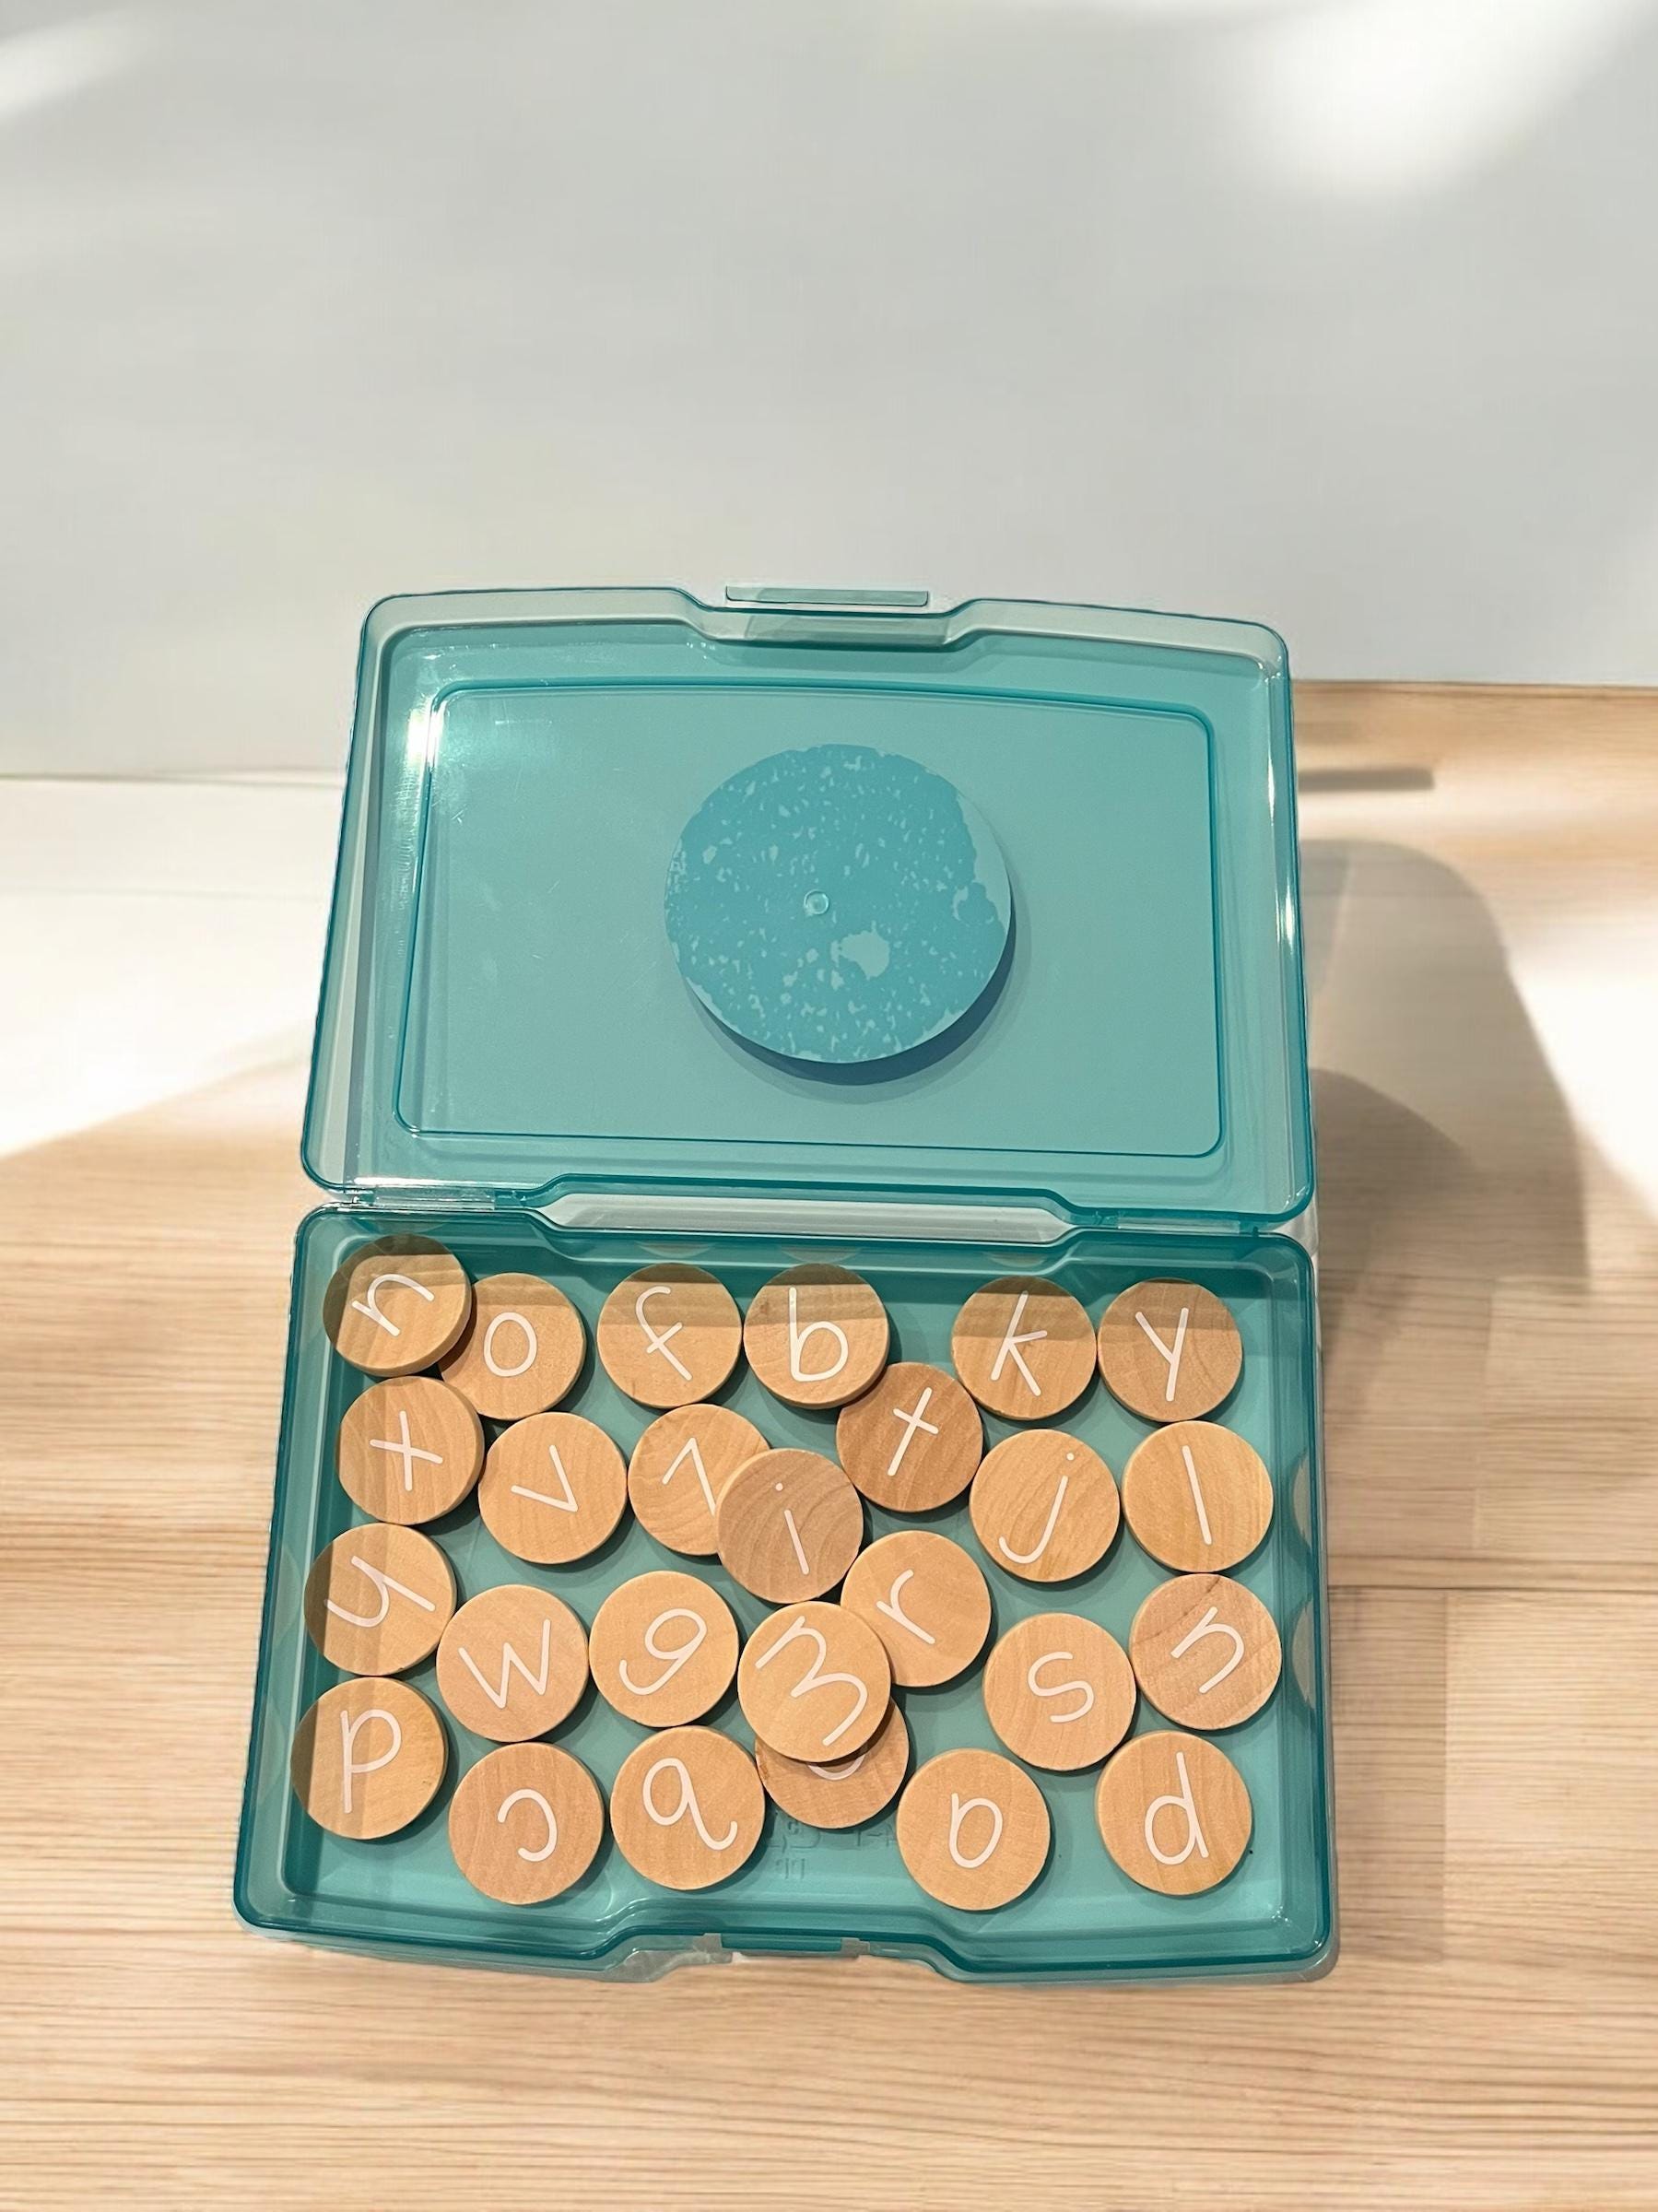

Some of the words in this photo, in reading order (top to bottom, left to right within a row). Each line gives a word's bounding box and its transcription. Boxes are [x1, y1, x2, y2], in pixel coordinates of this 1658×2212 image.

[635, 1285, 693, 1382] f
[788, 1286, 850, 1382] b
[990, 1290, 1048, 1397] k
[1135, 1306, 1190, 1402] y
[369, 1410, 443, 1491] x
[510, 1444, 579, 1513] v
[887, 1386, 939, 1477] t
[774, 1481, 810, 1575] i
[997, 1452, 1076, 1564] j
[875, 1569, 935, 1646] r
[458, 1619, 551, 1710] w
[754, 1617, 868, 1747] m
[1027, 1651, 1096, 1724] s
[340, 1708, 403, 1814] p
[1143, 1751, 1209, 1865] d
